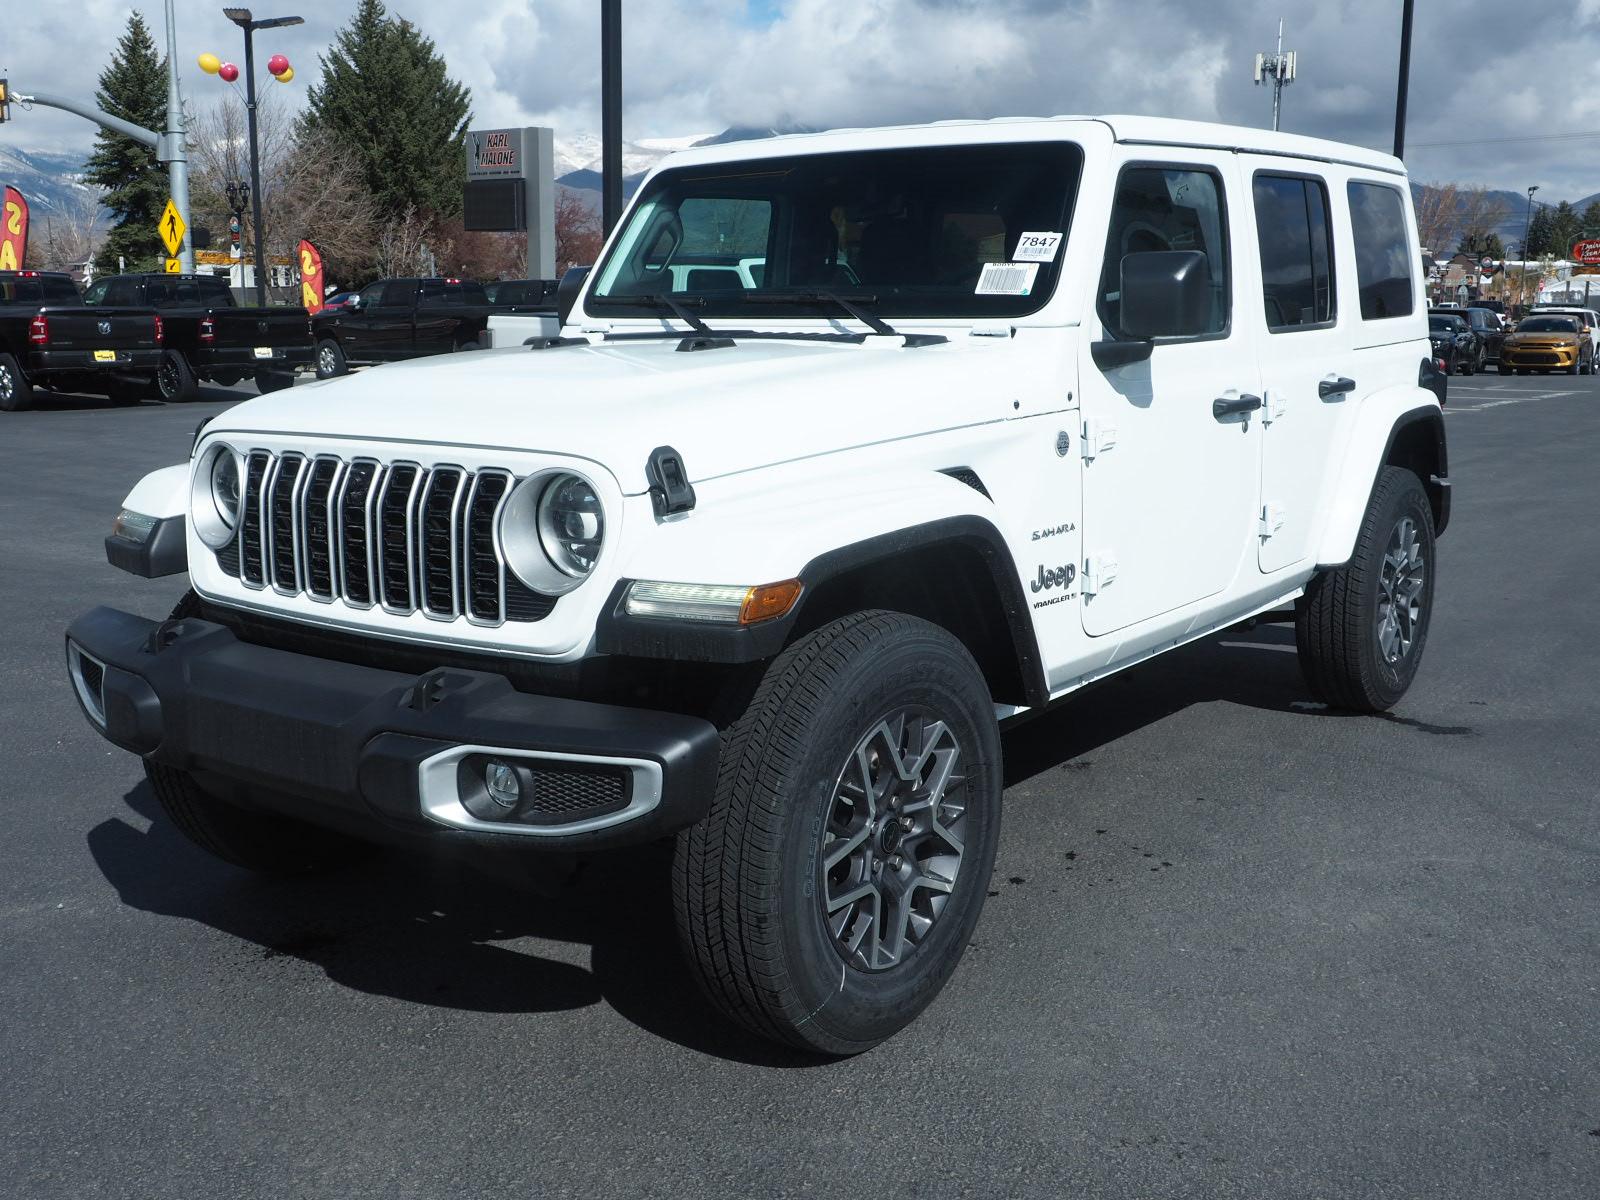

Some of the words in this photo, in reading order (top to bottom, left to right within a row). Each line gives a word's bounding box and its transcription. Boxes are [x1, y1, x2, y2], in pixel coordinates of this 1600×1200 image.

[486, 133, 509, 148] KARL
[480, 150, 515, 166] MALONE
[1021, 236, 1058, 247] 7847
[1031, 522, 1076, 541] SAHARA
[1030, 562, 1076, 594] Jeep
